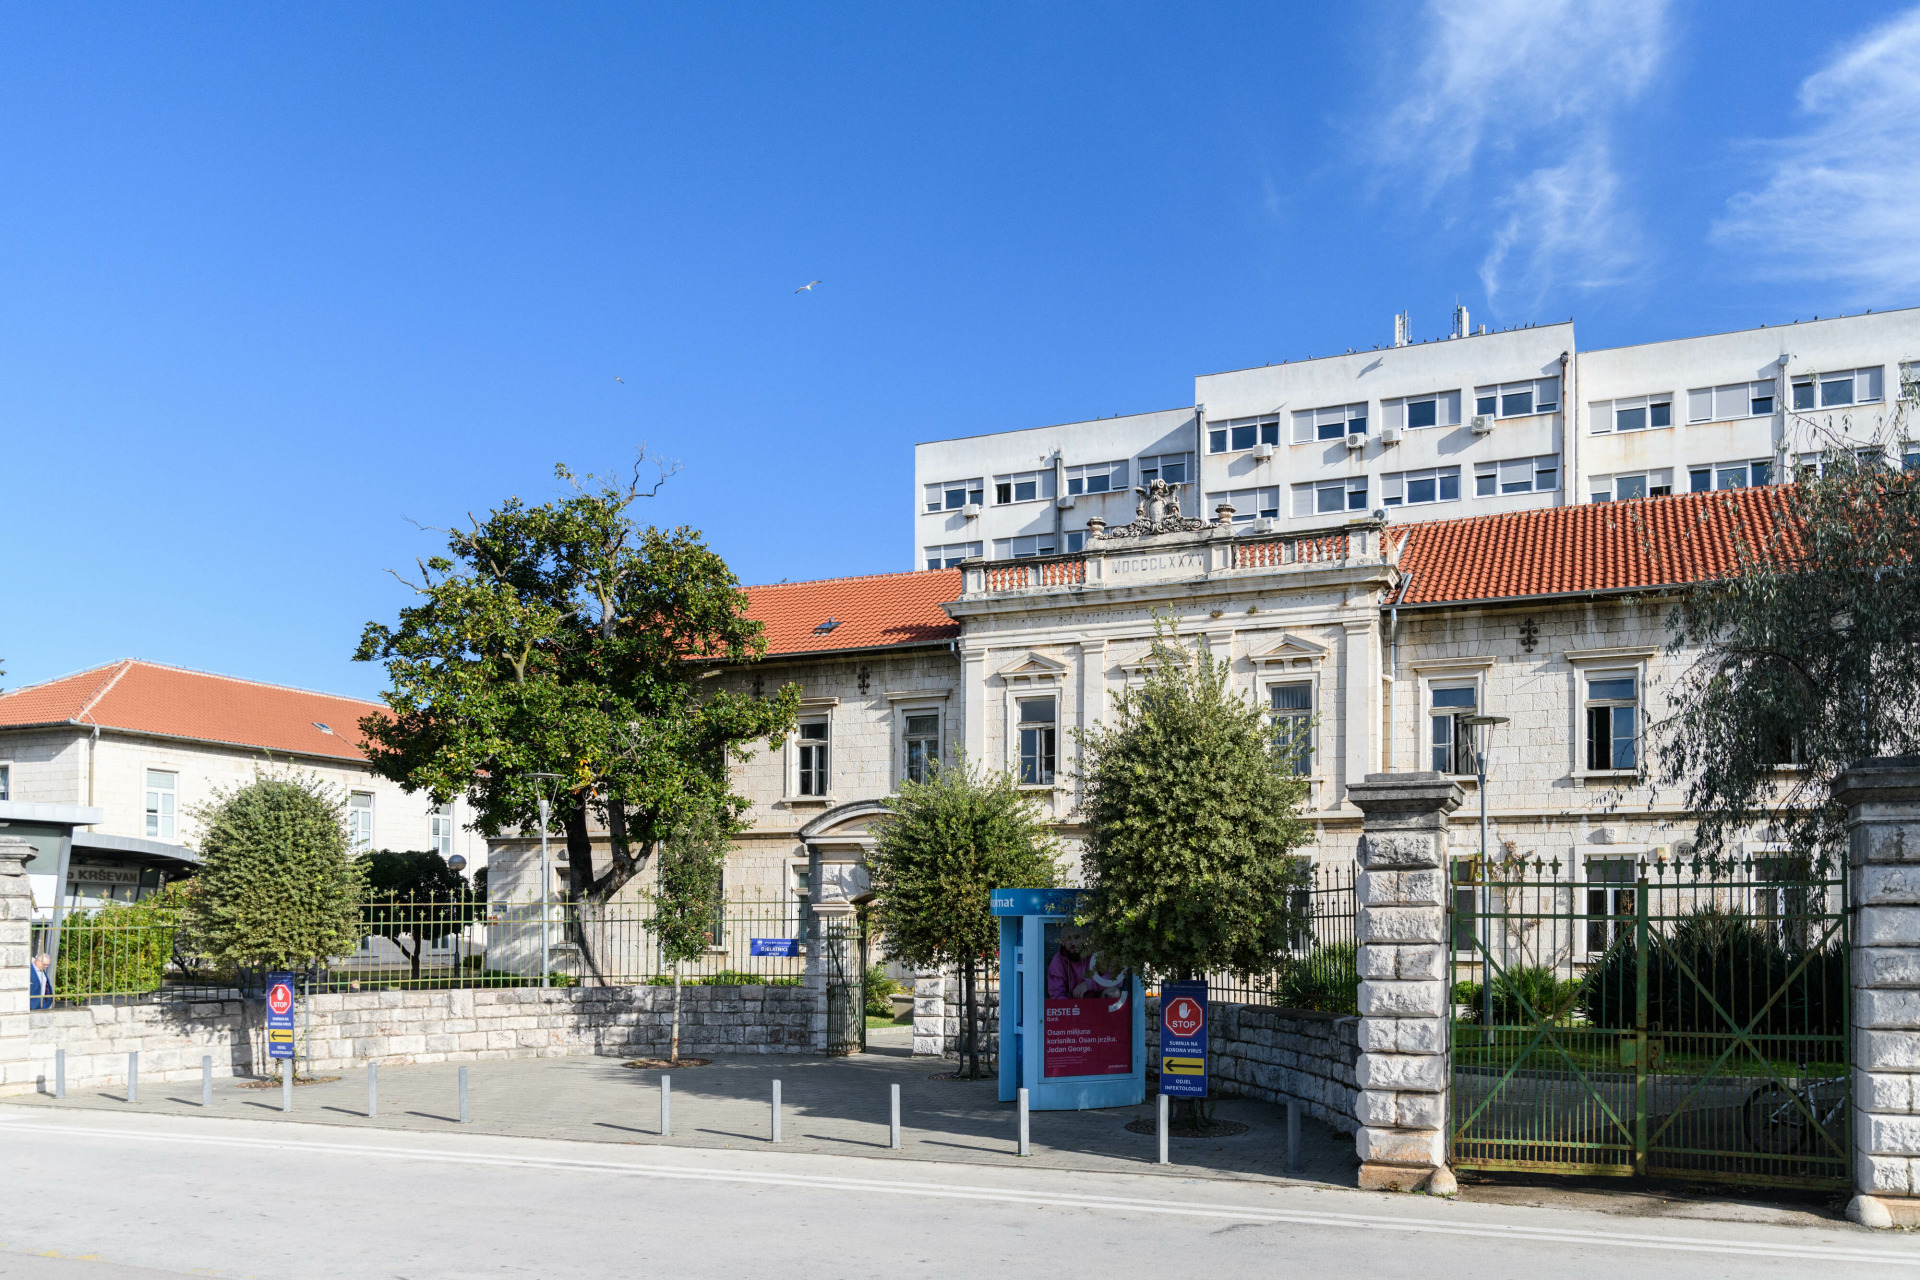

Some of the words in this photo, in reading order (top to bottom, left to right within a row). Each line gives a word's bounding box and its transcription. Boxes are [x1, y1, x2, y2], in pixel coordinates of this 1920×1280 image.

[78, 869, 137, 883] KRŠEVAN
[1046, 1008, 1071, 1016] ERSTE
[1171, 1020, 1196, 1029] STOP
[1066, 1028, 1091, 1037] milijuna
[1046, 1037, 1078, 1045] korisnika.
[1078, 1036, 1097, 1044] Osam
[1067, 1045, 1093, 1053] George.
